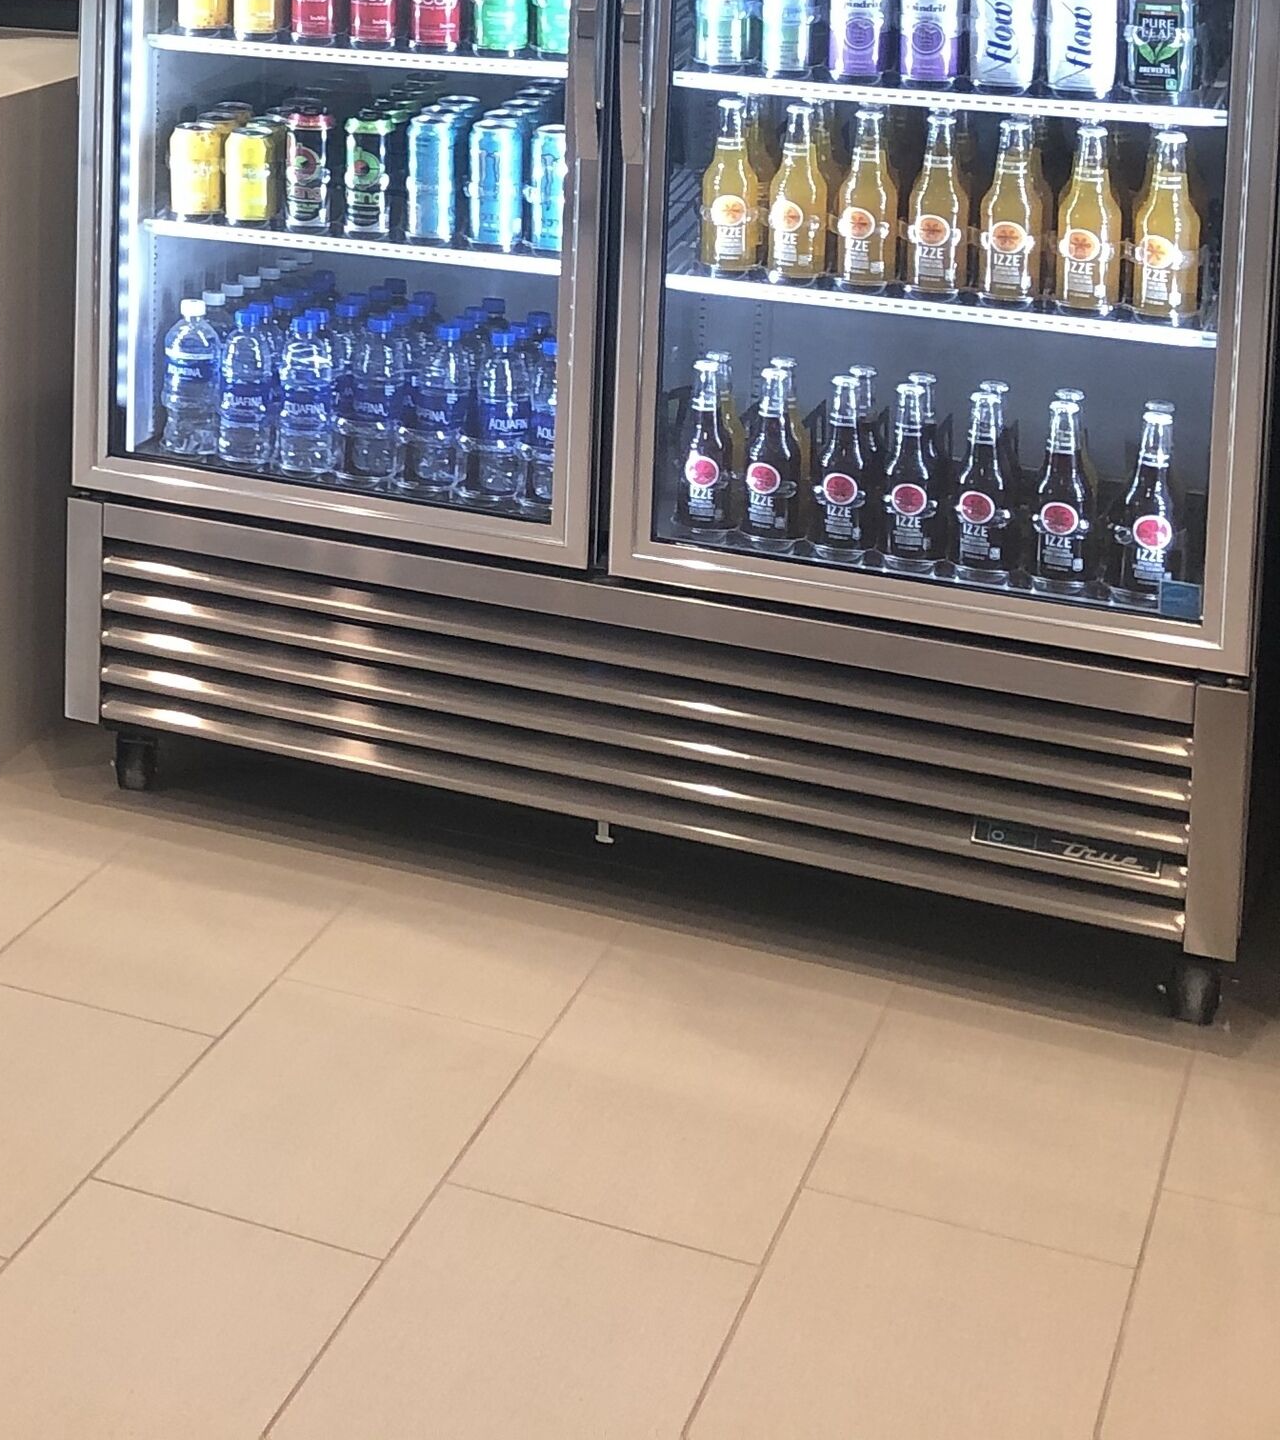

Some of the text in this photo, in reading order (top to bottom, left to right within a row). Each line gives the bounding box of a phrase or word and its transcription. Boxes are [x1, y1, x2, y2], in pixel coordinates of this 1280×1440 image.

[1142, 17, 1175, 29] PURE
[986, 1, 1013, 64] flow
[1065, 5, 1093, 70] flow
[719, 227, 742, 238] ZZE
[847, 240, 870, 252] ZZE
[993, 253, 1022, 265] IZZE
[1145, 269, 1170, 283] ZZE
[489, 417, 529, 436] AQUAFIN
[749, 491, 774, 508] IZZE
[826, 505, 852, 519] IZZE
[895, 515, 922, 529] IZZE
[962, 522, 989, 538] IZZE
[1044, 534, 1073, 550] IZZE
[1136, 547, 1165, 563] IZZE
